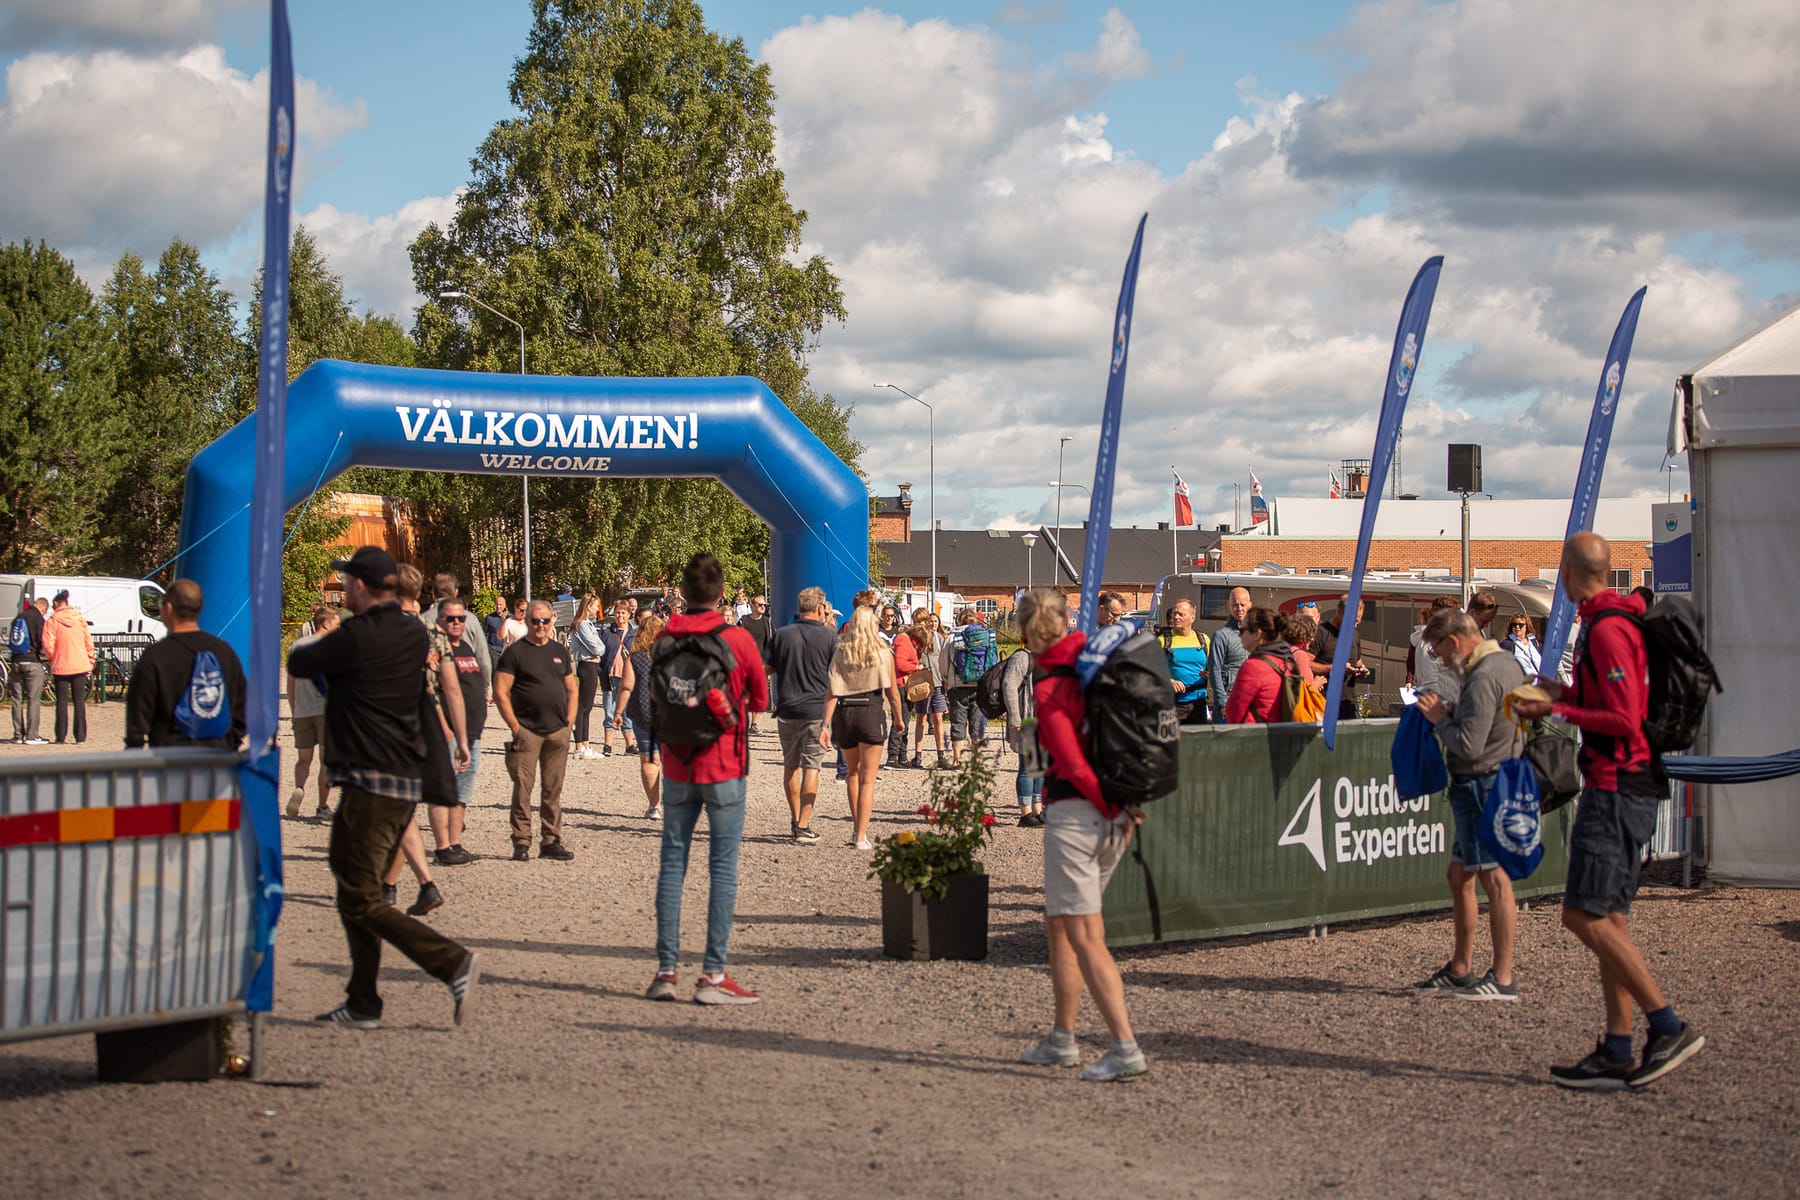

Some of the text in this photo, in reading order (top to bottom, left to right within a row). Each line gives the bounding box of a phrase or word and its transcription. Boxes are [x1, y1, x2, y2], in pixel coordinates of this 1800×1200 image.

[395, 398, 698, 450] VÄLKOMMEN!
[480, 453, 611, 472] WELCOME
[1334, 818, 1445, 866] Experten
